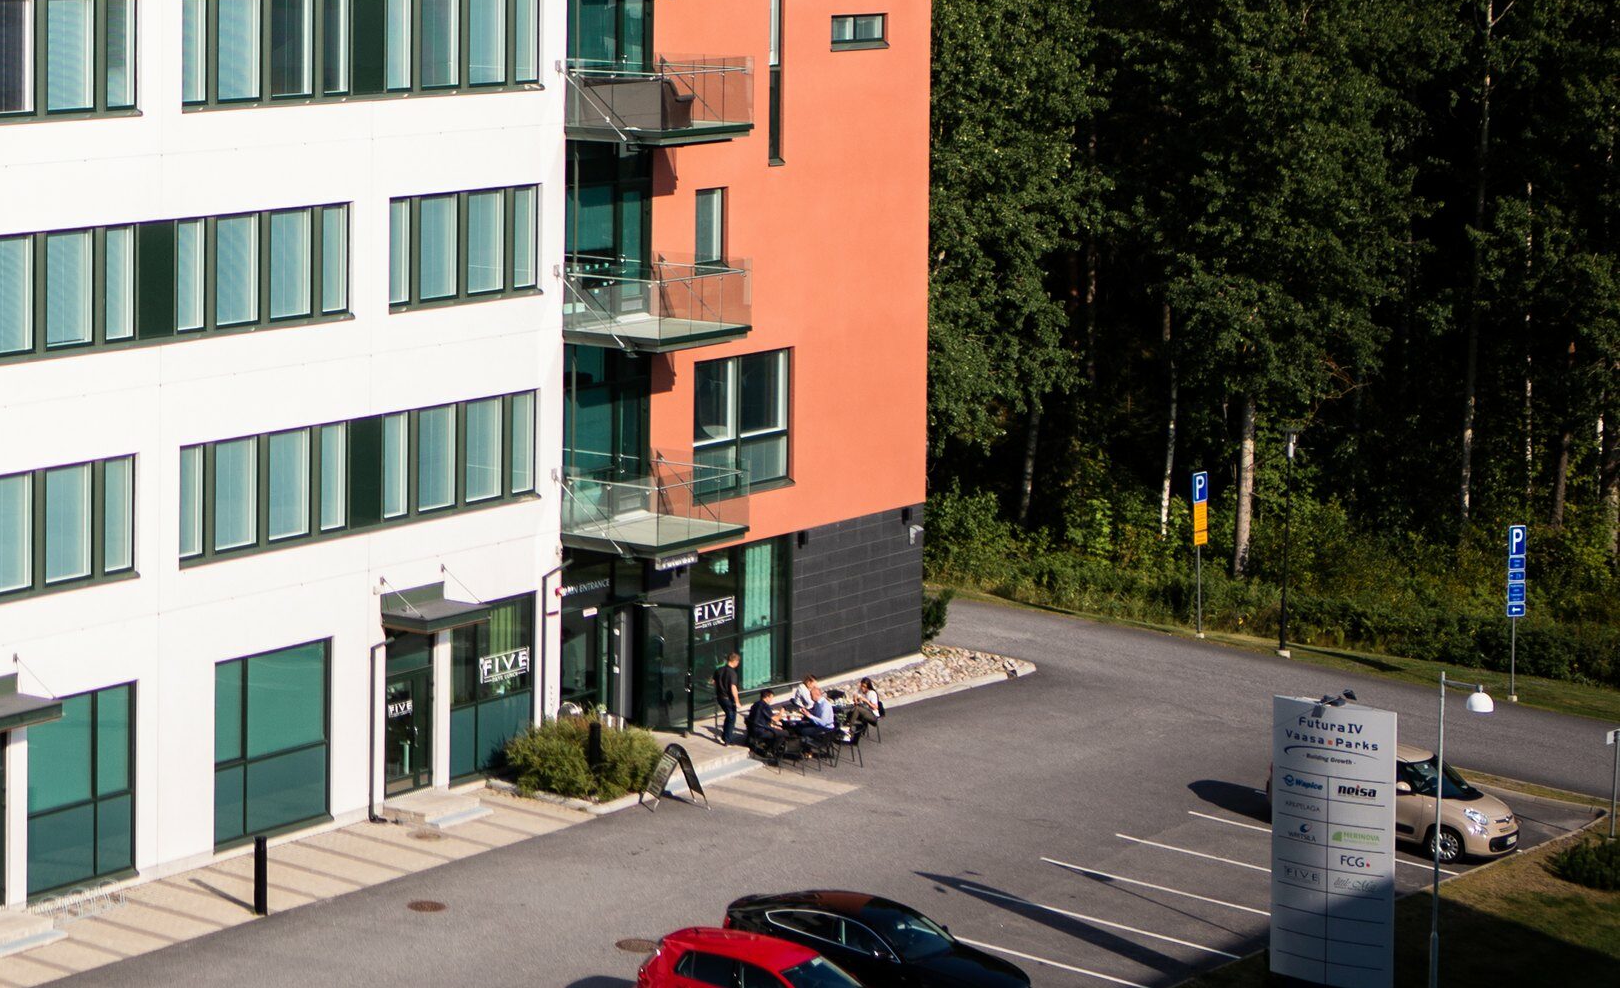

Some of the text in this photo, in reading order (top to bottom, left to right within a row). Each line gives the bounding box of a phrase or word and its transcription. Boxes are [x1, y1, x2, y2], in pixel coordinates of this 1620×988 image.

[1196, 475, 1205, 500] P
[1512, 528, 1523, 554] P
[694, 599, 732, 623] FIVE
[483, 651, 527, 676] FIVE
[389, 701, 412, 714] FIVE
[1298, 716, 1363, 734] Futura IV
[1285, 729, 1378, 751] Vaasa Parks
[1294, 778, 1323, 791] Wapice
[1337, 784, 1377, 799] neisa
[1286, 867, 1319, 882] FIVE
